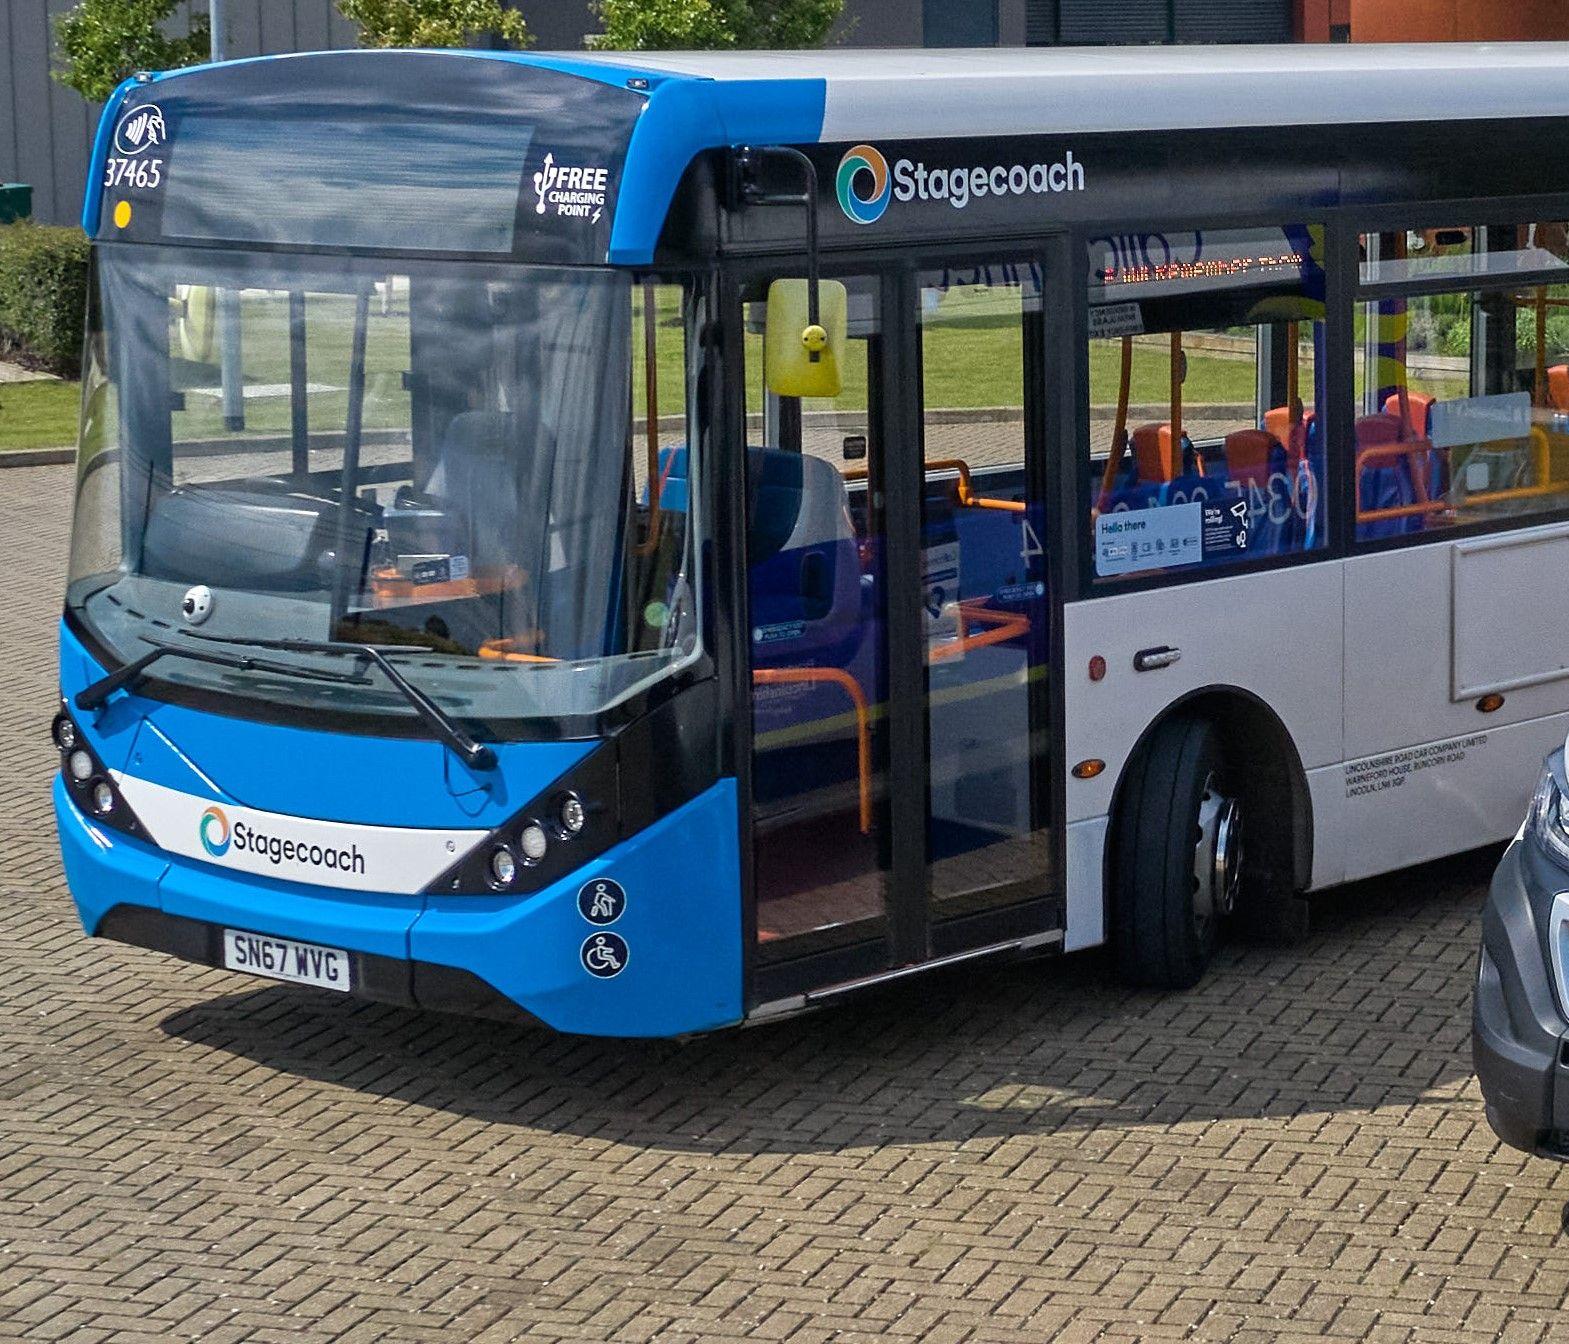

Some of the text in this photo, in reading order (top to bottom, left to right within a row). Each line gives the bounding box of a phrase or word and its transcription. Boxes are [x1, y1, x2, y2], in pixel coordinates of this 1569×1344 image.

[104, 158, 163, 188] 37465
[556, 167, 609, 190] FREE
[893, 150, 1085, 208] Stagecoach
[548, 191, 605, 205] CHARGING
[557, 203, 592, 217] POINT
[1101, 519, 1146, 535] Hello there
[1461, 735, 1488, 749] LIMITED
[233, 822, 365, 874] Stagecoach
[234, 936, 338, 981] SN67 WVG
